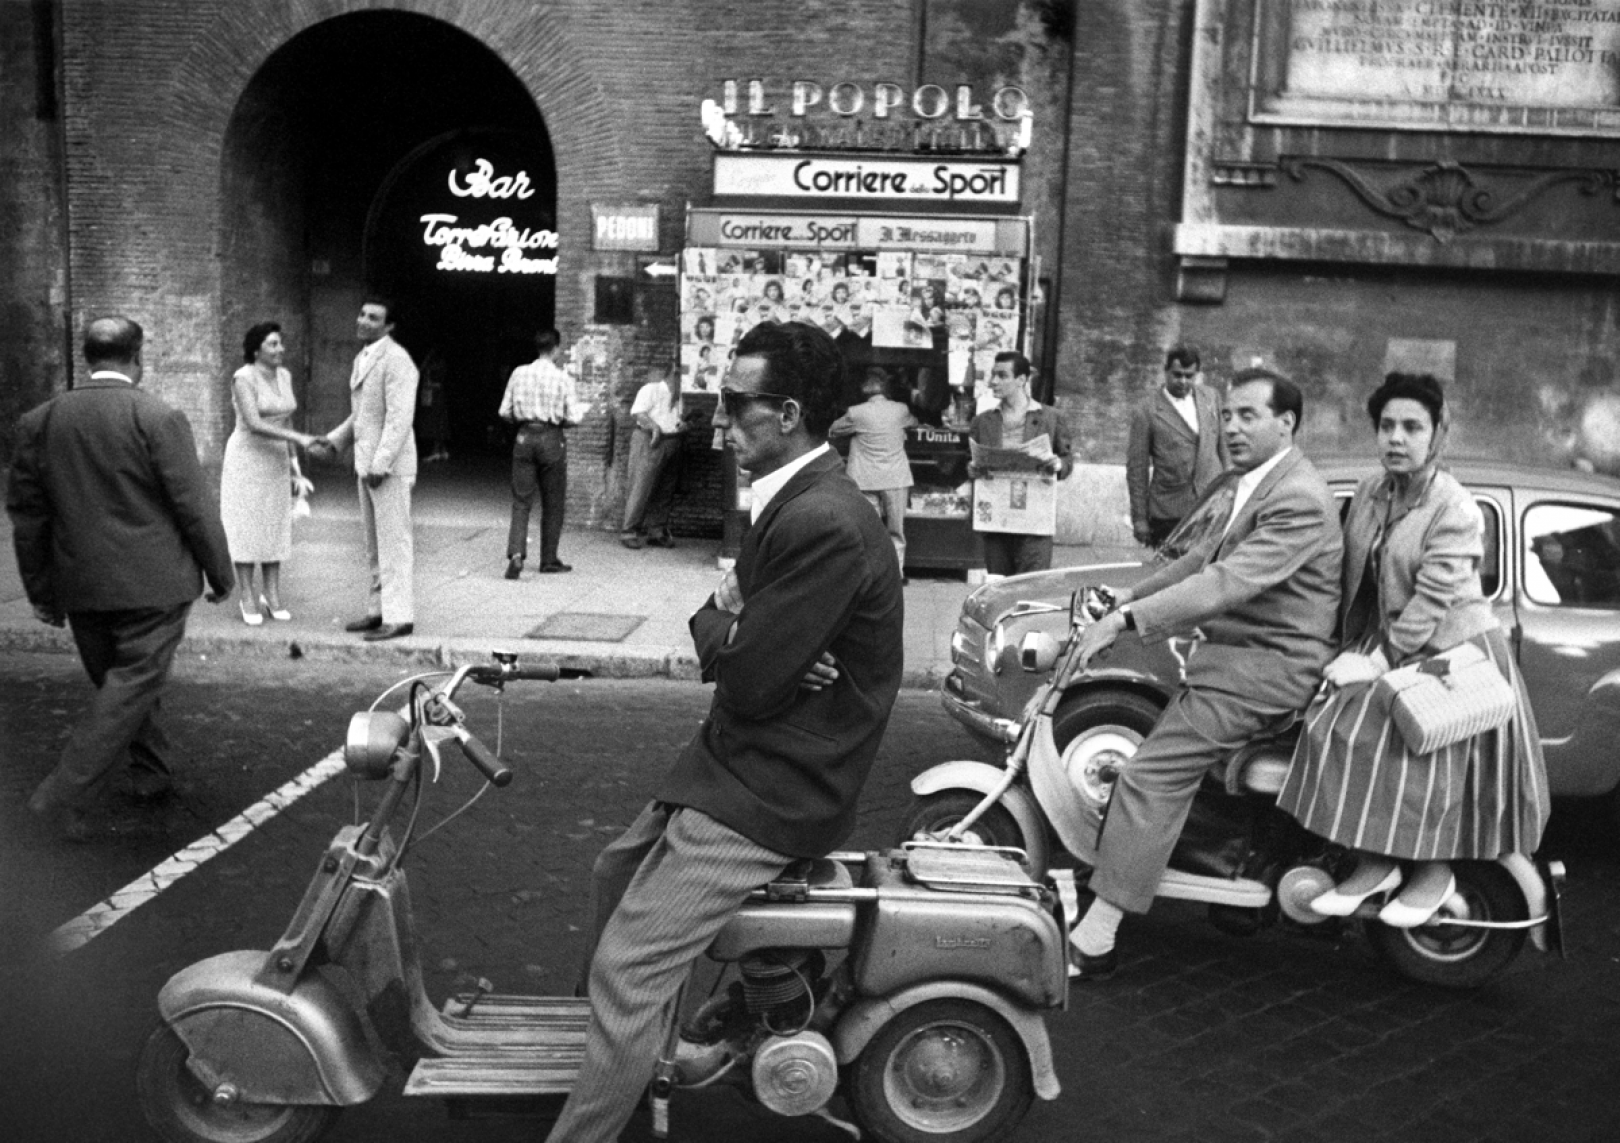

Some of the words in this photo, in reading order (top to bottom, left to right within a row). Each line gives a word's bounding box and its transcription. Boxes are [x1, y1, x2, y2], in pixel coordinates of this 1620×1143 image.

[723, 79, 774, 116] IL
[791, 80, 1029, 121] POPOLO
[448, 158, 535, 200] Bar
[794, 160, 908, 195] Corriere
[932, 164, 1008, 199] Sport
[721, 219, 793, 241] Corriere
[807, 220, 858, 245] Sport
